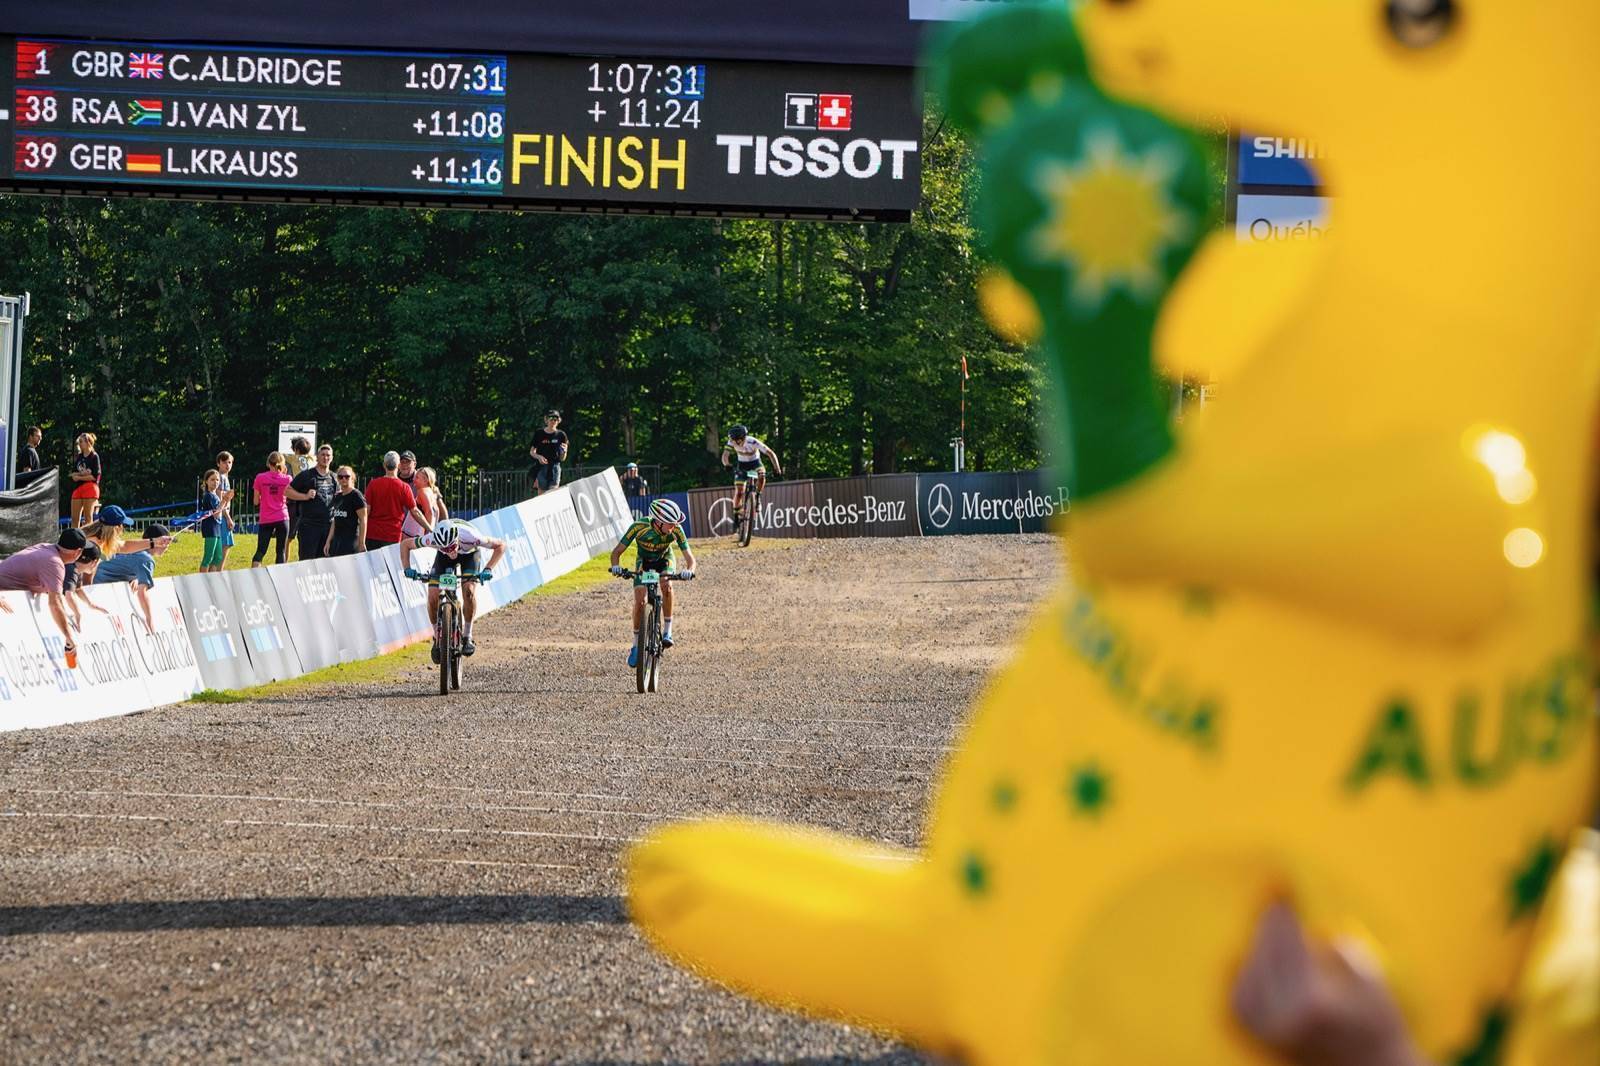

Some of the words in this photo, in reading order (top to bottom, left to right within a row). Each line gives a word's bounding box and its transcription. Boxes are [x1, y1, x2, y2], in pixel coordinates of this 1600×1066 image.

[35, 50, 50, 75] 1
[72, 51, 124, 78] GBR
[168, 55, 342, 86] C.ALDRIDGE
[405, 64, 504, 91] 1:07:31
[587, 63, 701, 94] 1:07:31
[25, 96, 57, 122] 38
[72, 98, 124, 125] RSA
[167, 102, 248, 129] J.VAN
[256, 105, 306, 132] ZYL
[412, 111, 503, 138] +11:08
[618, 98, 701, 129] 11:24
[24, 142, 57, 168] 39
[70, 144, 123, 170] GER
[167, 148, 298, 178] L.KRAUSS
[411, 158, 502, 185] +11:16
[511, 133, 686, 190] FINISH
[716, 134, 918, 180] TISSOT
[753, 496, 906, 530] Mercedes-Benz
[961, 486, 1072, 520] Mercedes-B
